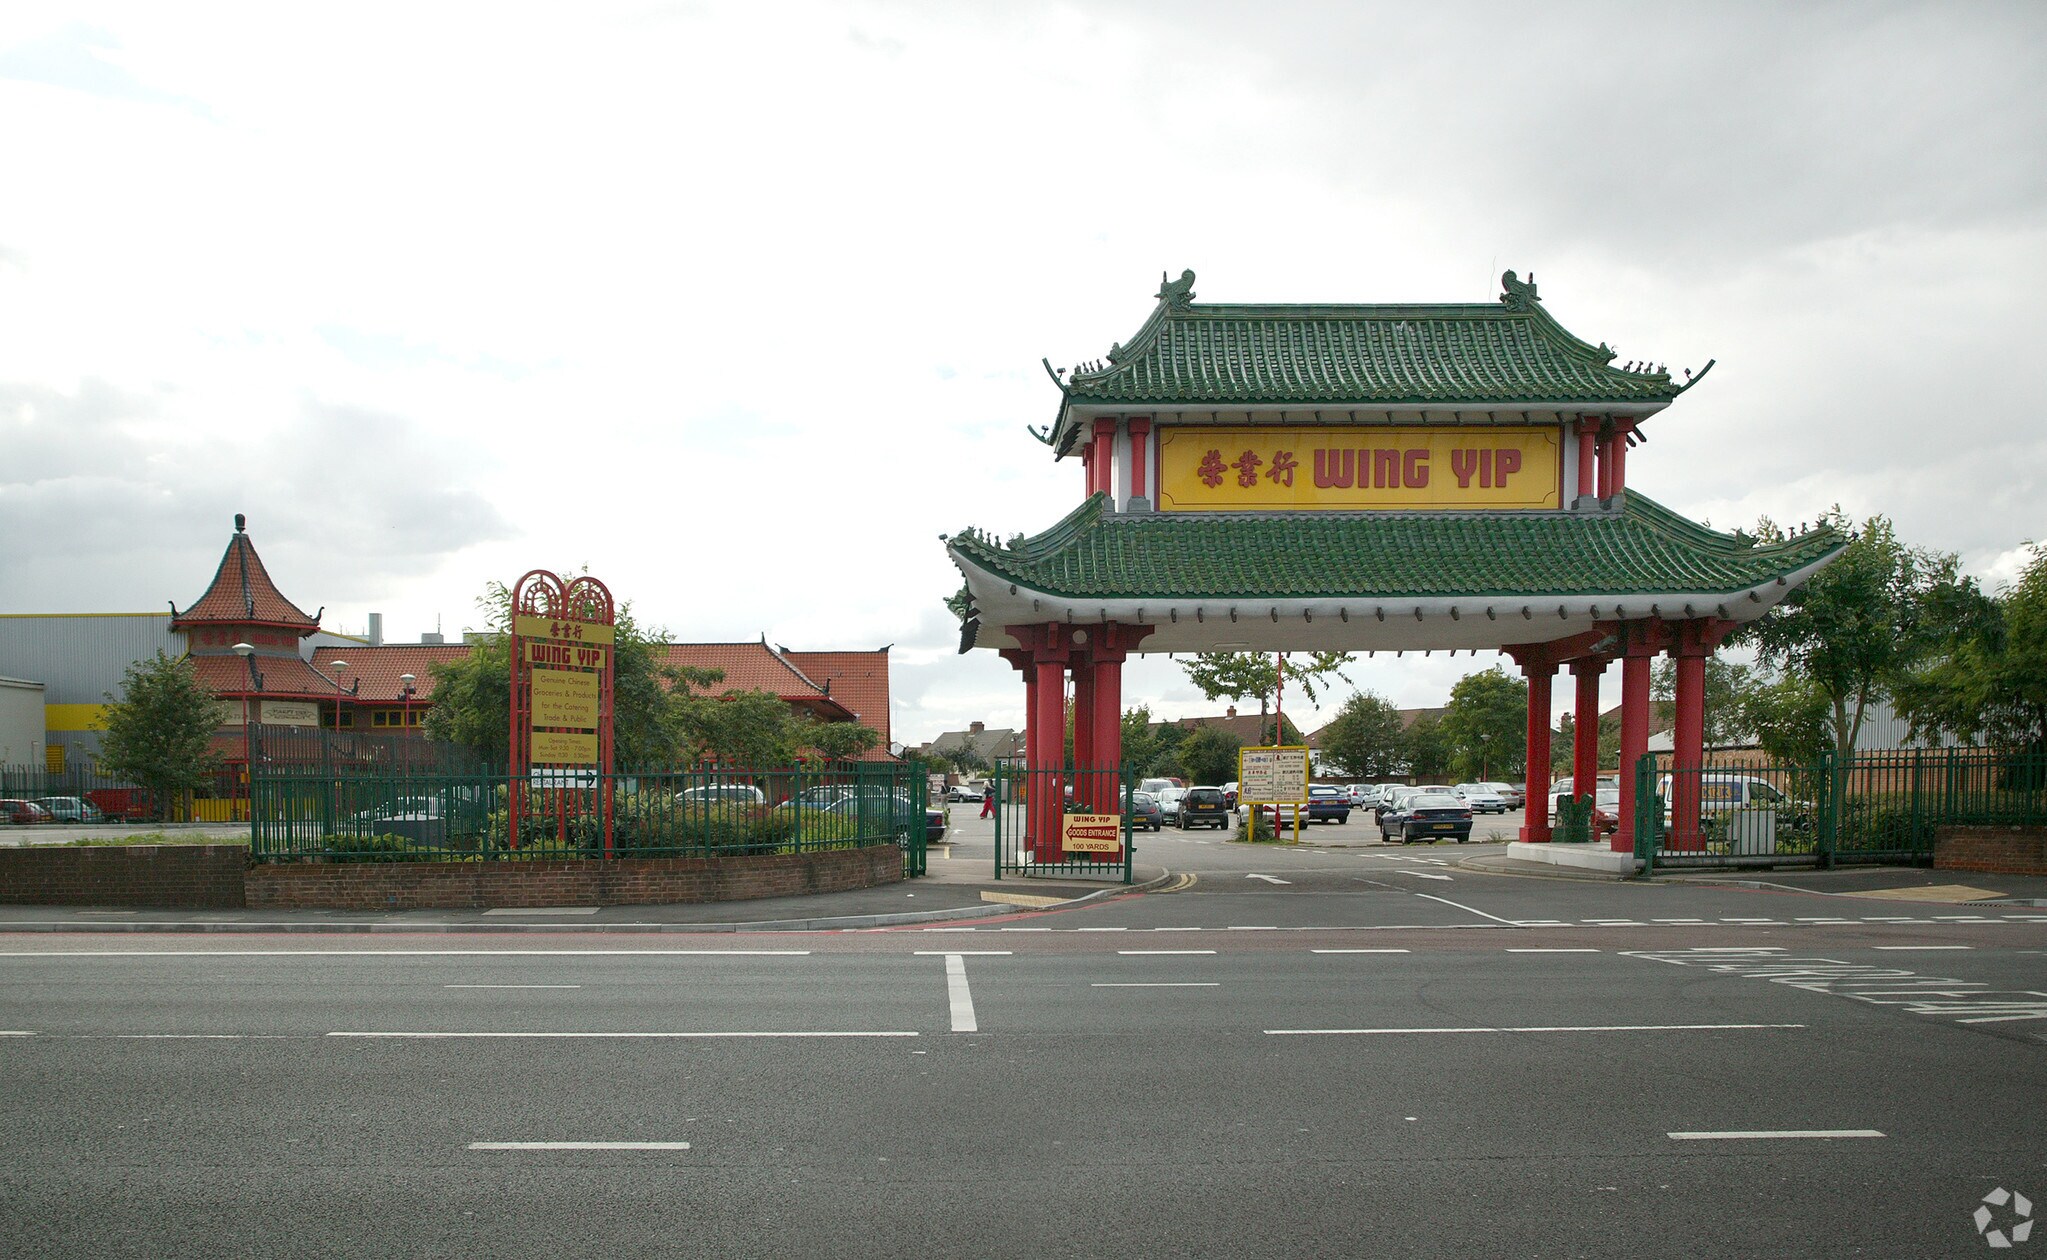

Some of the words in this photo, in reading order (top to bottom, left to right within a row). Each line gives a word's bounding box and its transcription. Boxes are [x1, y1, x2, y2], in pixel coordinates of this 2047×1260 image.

[1314, 449, 1430, 488] WING
[1452, 449, 1522, 488] YIP
[531, 644, 571, 664] WING
[577, 648, 600, 667] YIP
[540, 675, 566, 685] Genuine
[567, 677, 590, 687] Chinese
[533, 688, 563, 697] Groceries
[572, 690, 597, 700] Products
[541, 701, 550, 709] for
[552, 702, 562, 710] the
[564, 703, 589, 713] Catering
[543, 713, 560, 722] Trade
[570, 715, 588, 723] Public
[1067, 828, 1087, 837] GOODS
[1087, 829, 1116, 837] ENTRANCE
